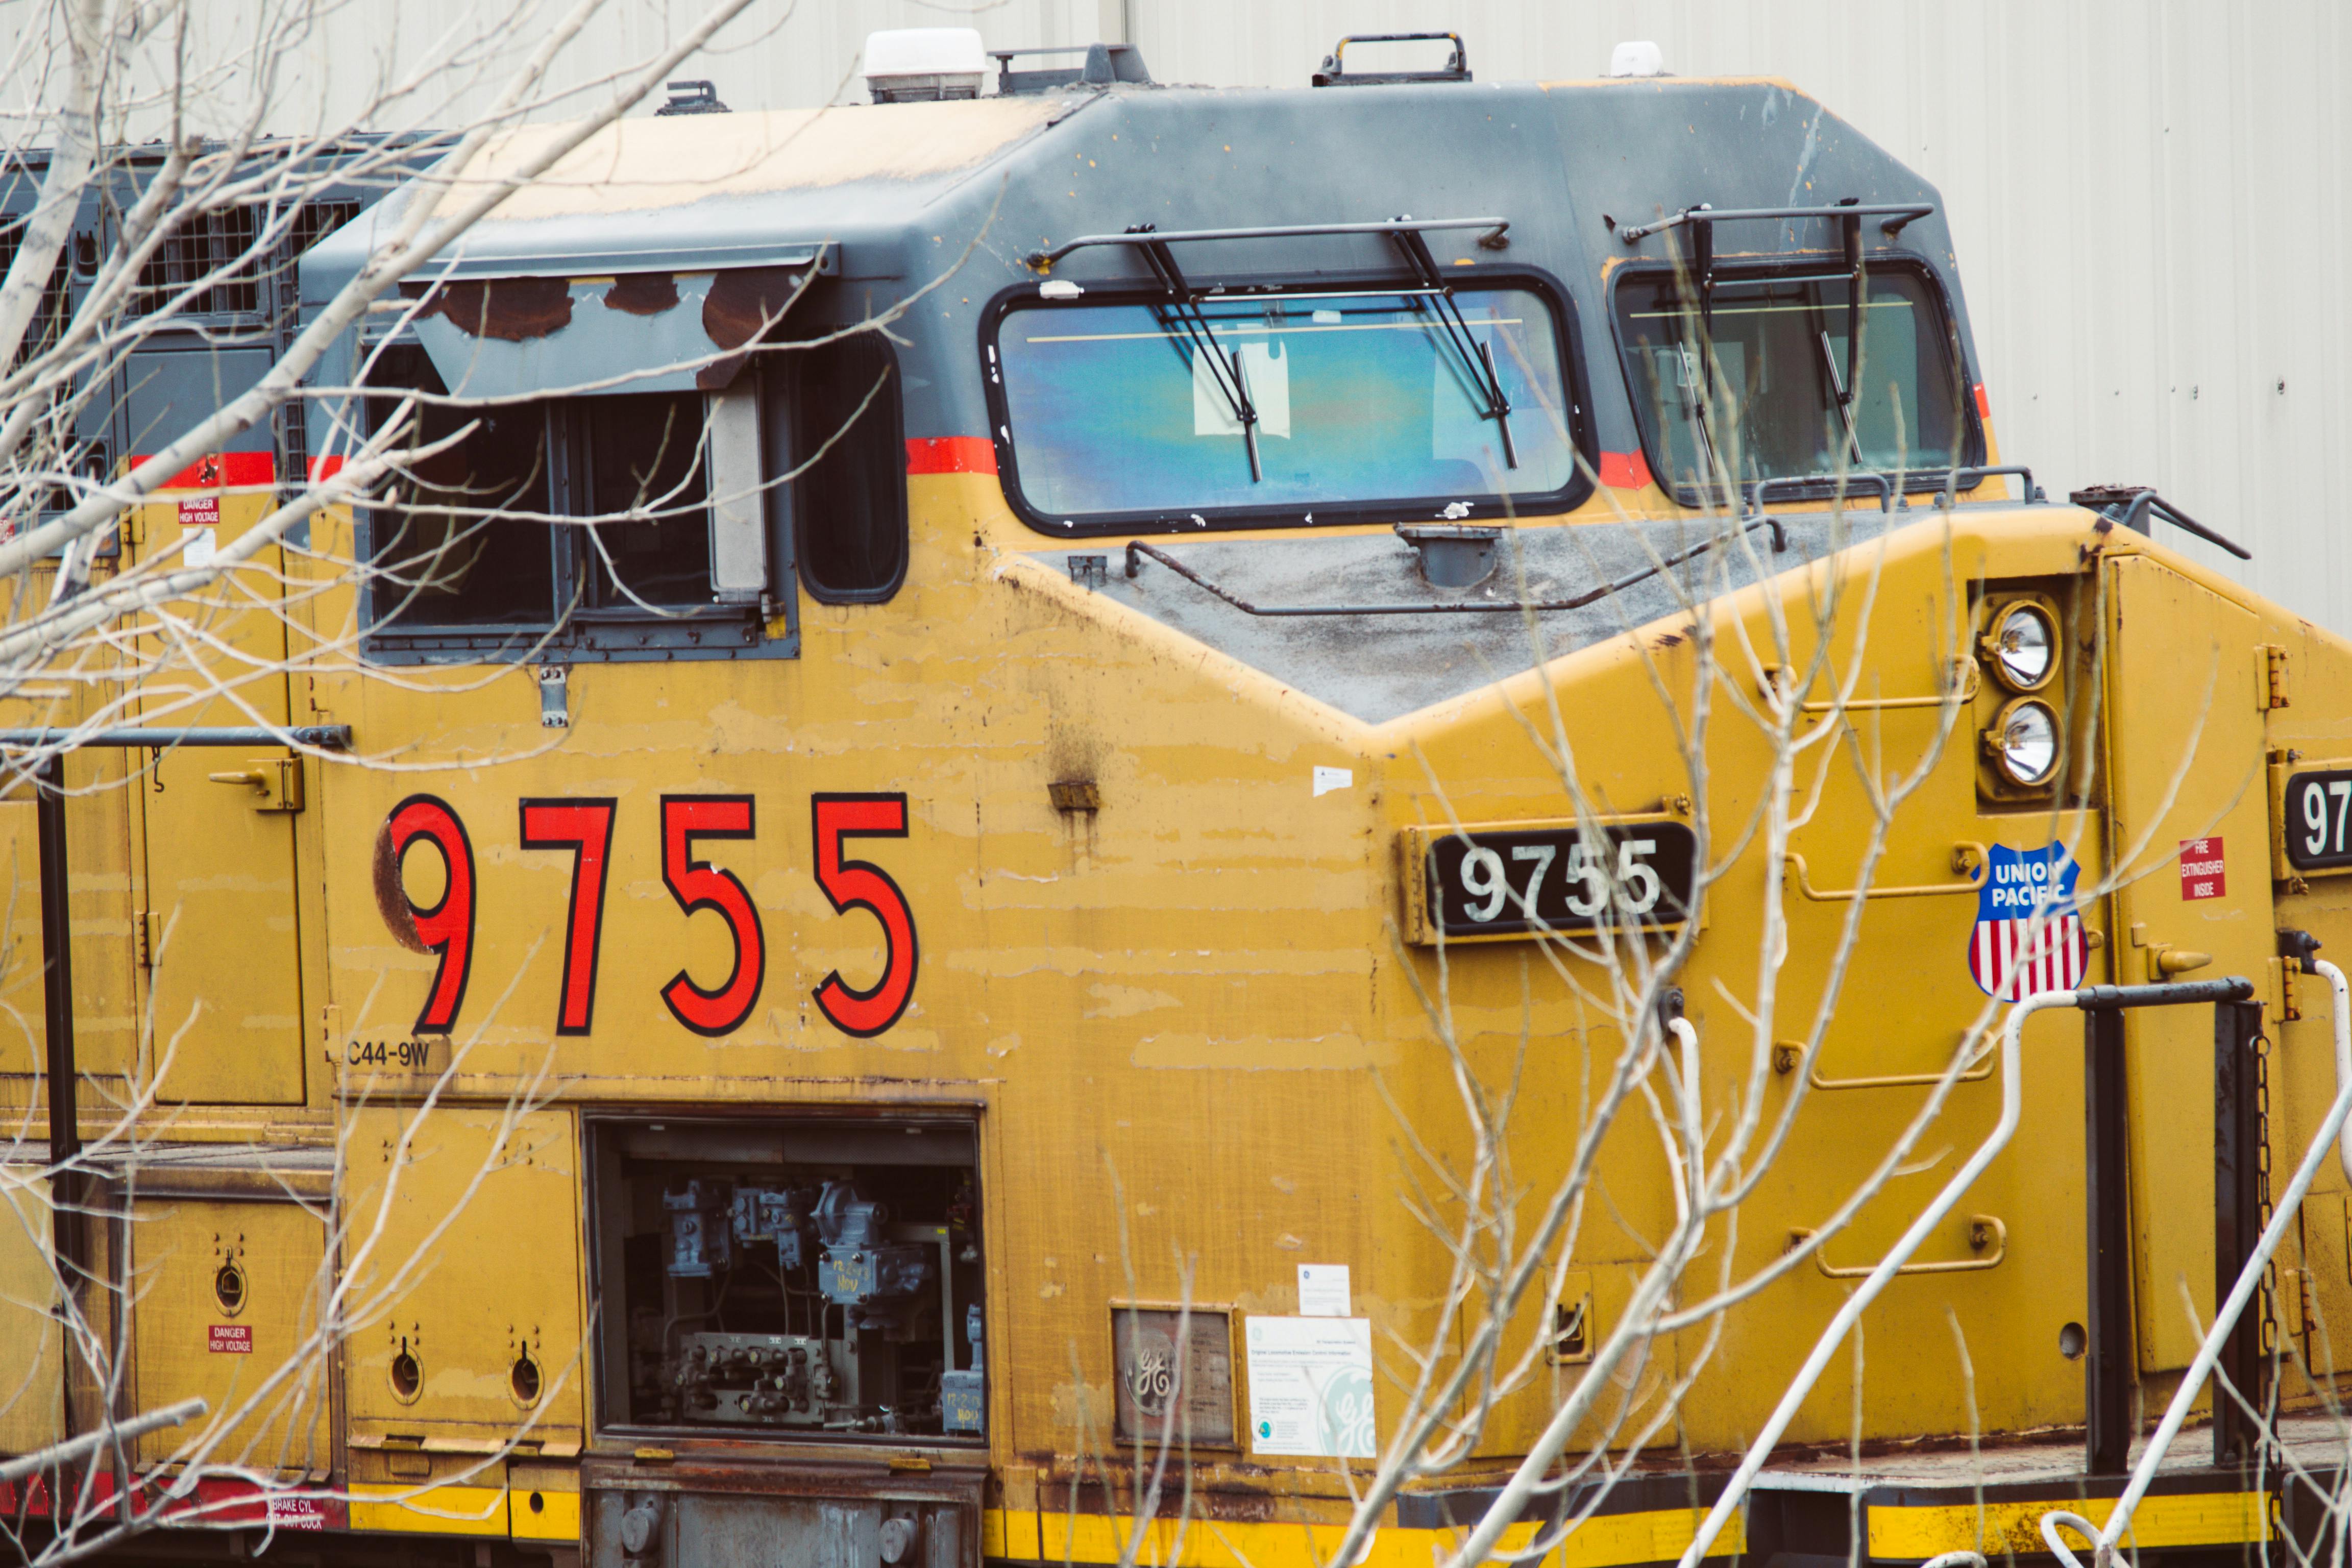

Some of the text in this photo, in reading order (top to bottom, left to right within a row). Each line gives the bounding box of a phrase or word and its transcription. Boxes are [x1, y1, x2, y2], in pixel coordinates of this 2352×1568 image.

[183, 499, 213, 509] DANGER
[179, 512, 218, 522] HIGH VOLTAGE
[2195, 841, 2209, 854] FIRE
[1996, 862, 2060, 884] UNION
[2182, 860, 2224, 877] EXTINGUISHER
[1460, 839, 1660, 922] 9755
[2194, 882, 2214, 897] INSIDE
[373, 792, 919, 1038] 9755
[348, 1041, 429, 1067] C44-9W
[214, 1327, 245, 1338] DANGER
[210, 1340, 251, 1352] HIGH VOLTAGE
[272, 1498, 315, 1513] BRAKE CYL.
[301, 1515, 322, 1530] COCK
